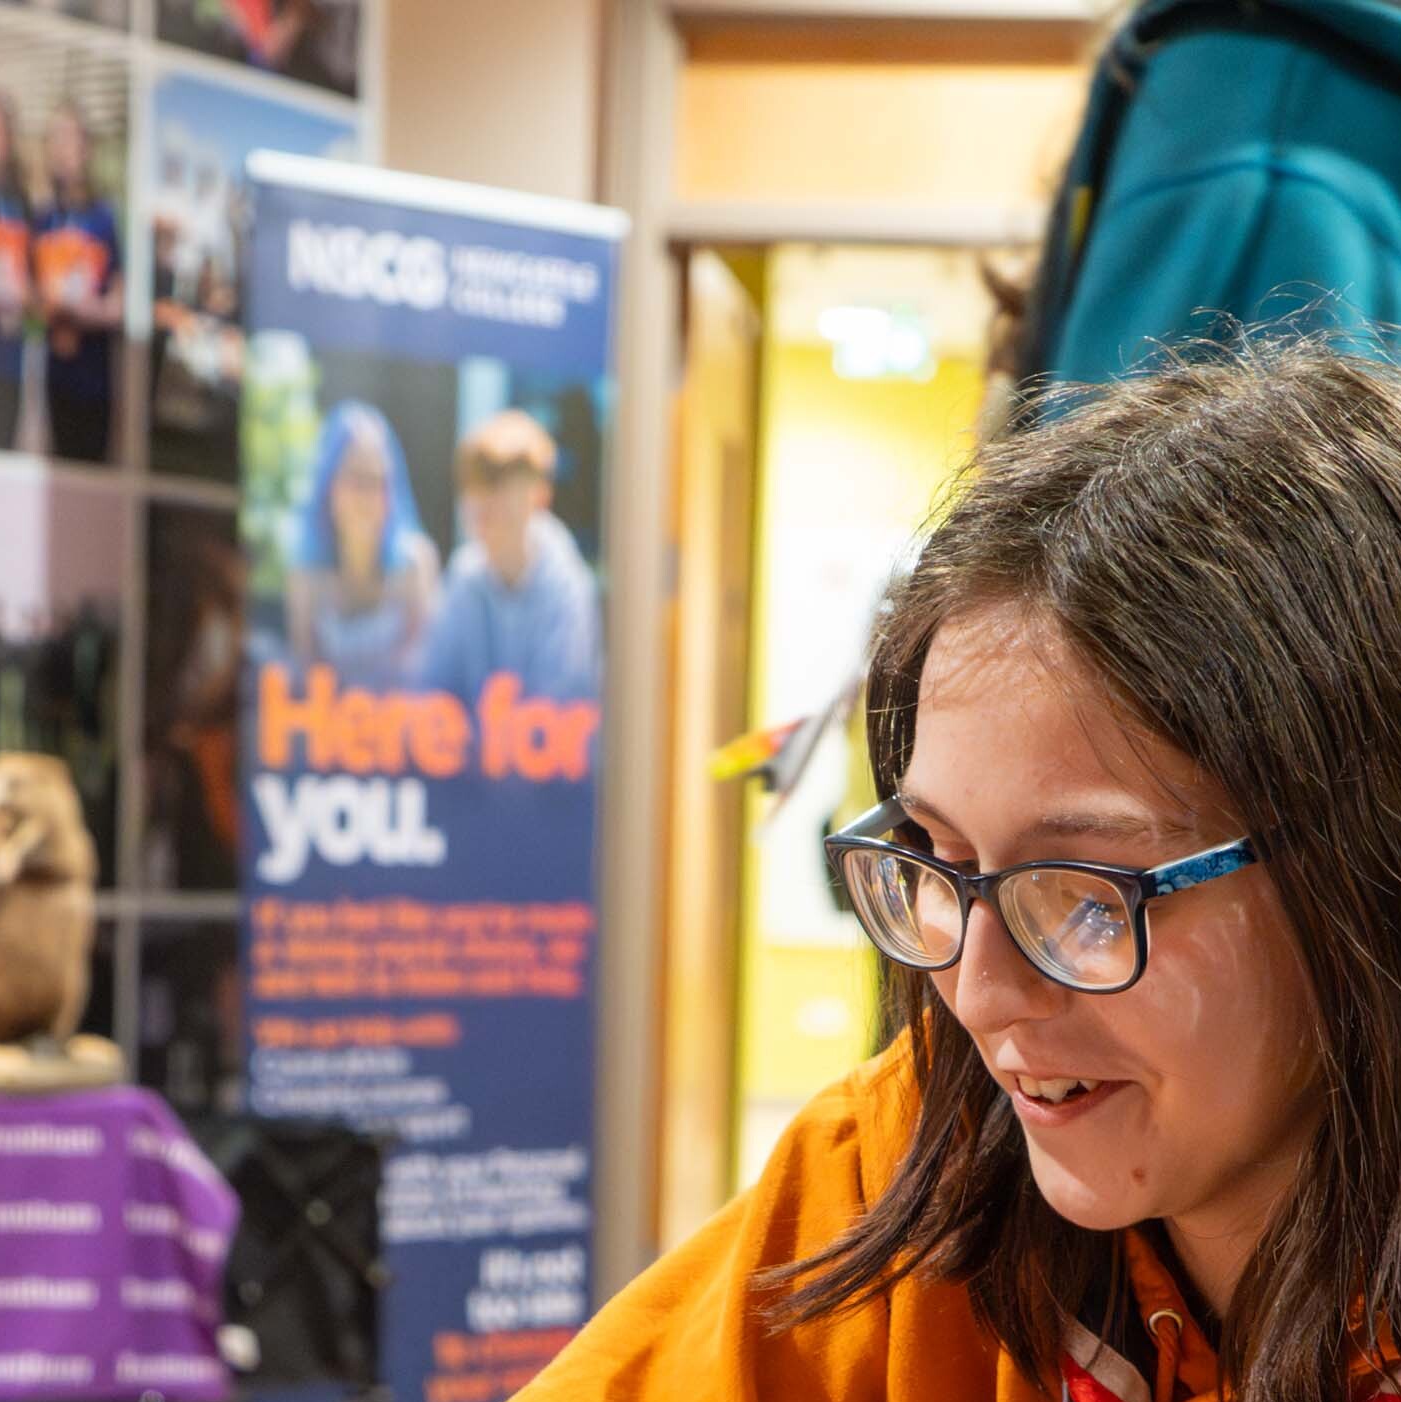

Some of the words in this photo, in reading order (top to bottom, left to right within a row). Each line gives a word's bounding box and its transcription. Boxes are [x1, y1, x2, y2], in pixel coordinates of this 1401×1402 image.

[287, 219, 449, 311] NSCG
[259, 663, 468, 777] Here
[480, 670, 599, 782] for
[253, 774, 447, 884] you.
